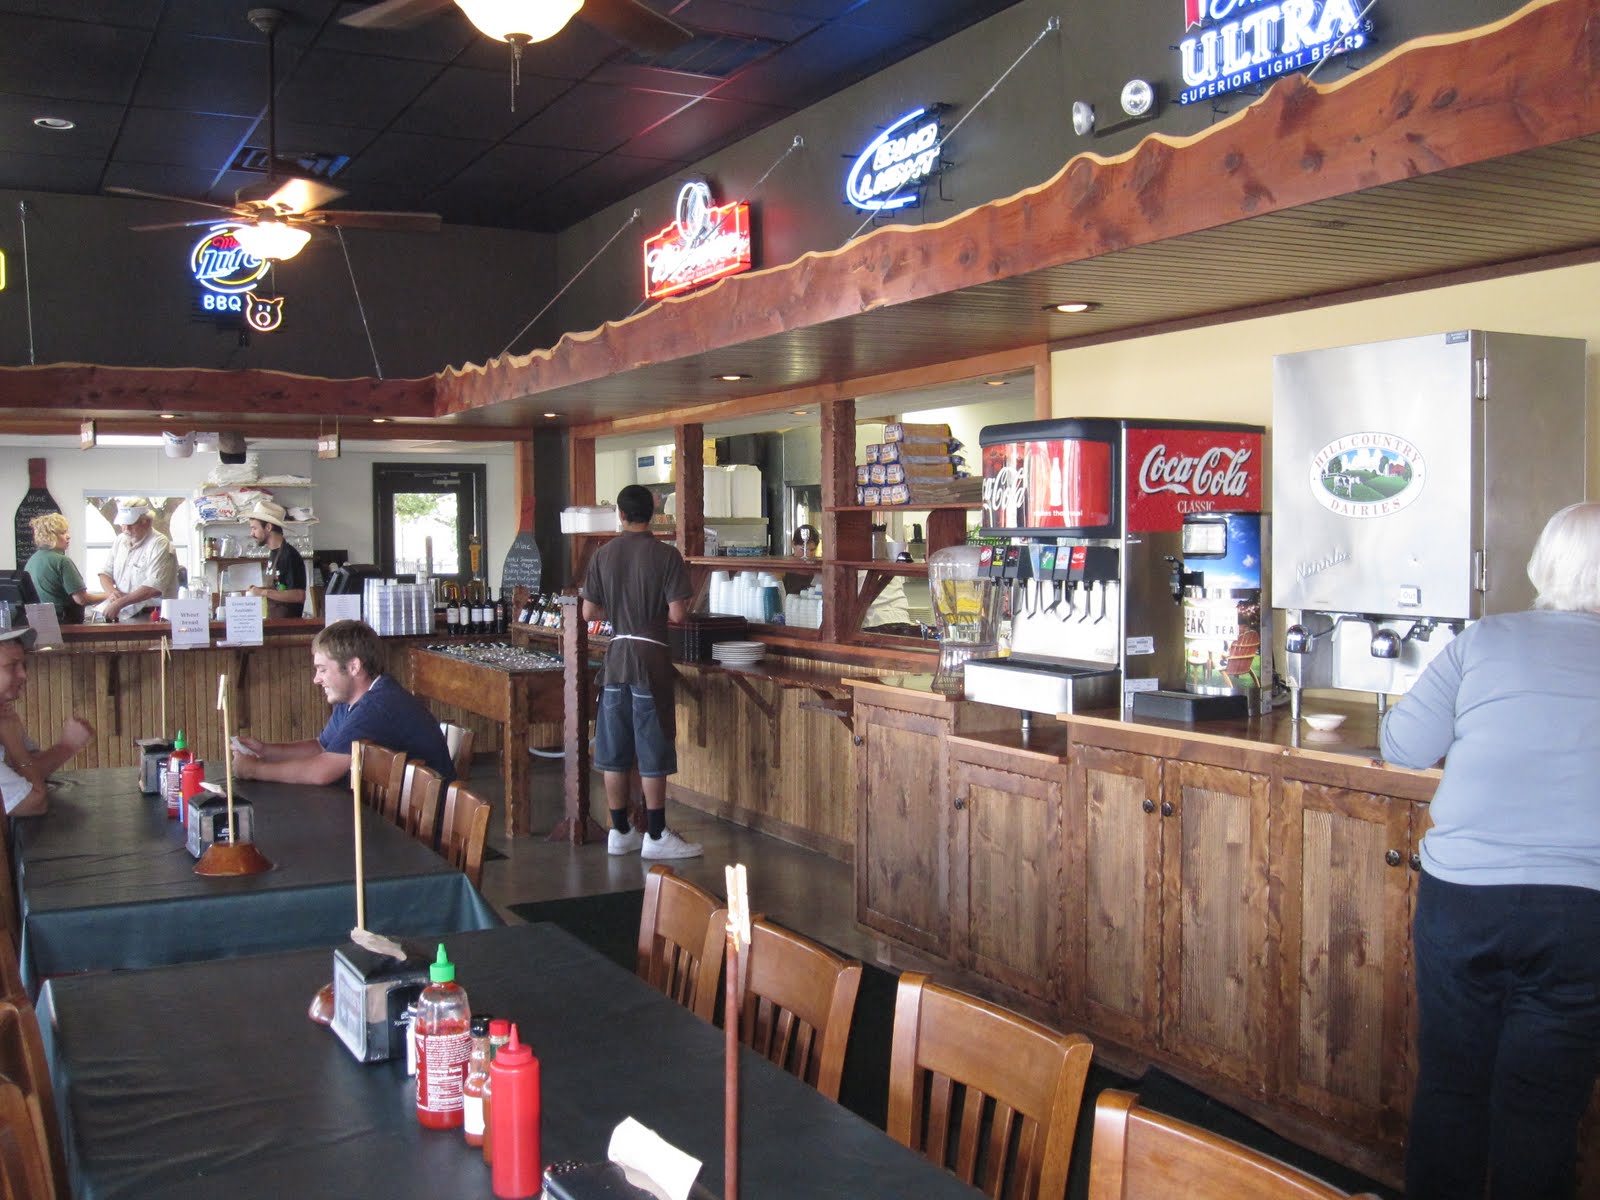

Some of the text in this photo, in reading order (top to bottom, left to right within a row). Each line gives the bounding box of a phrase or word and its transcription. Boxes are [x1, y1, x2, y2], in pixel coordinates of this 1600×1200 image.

[1180, 0, 1359, 86] ULTRA
[1181, 70, 1251, 105] SUPERIOR
[1258, 53, 1303, 78] LIGHT
[203, 294, 242, 312] BBQ
[1315, 434, 1421, 468] HILL COUNTRY
[1138, 444, 1253, 496] Coca-Cola
[1177, 500, 1216, 513] CLASSIC
[1330, 498, 1401, 516] DAIRIES
[1186, 609, 1206, 618] OLD
[1186, 617, 1206, 634] EAK
[1215, 625, 1235, 635] TEA
